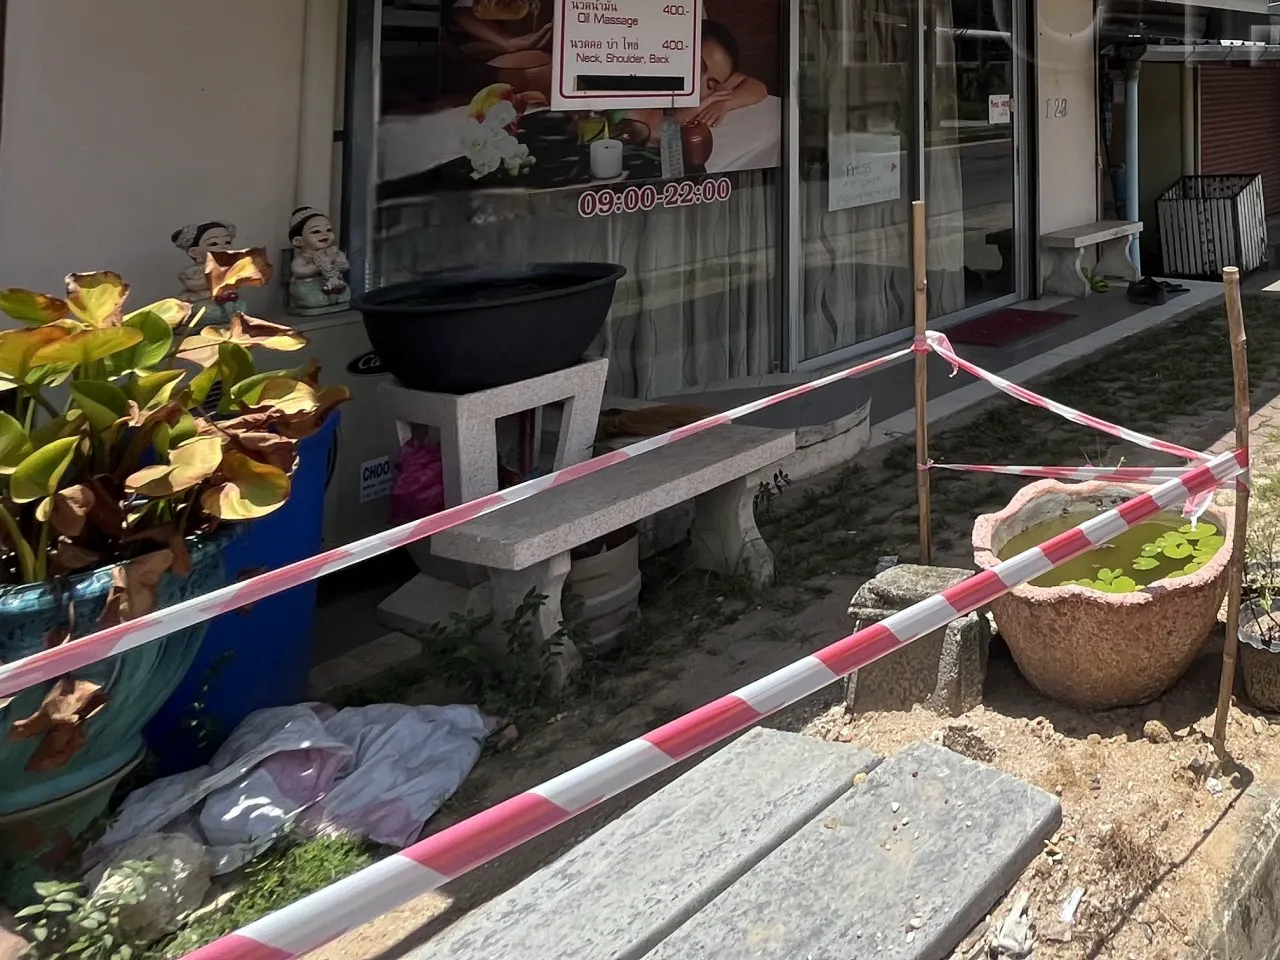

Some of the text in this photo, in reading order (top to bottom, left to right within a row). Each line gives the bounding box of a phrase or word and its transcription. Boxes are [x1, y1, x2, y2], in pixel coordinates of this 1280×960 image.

[577, 12, 639, 28] Oil Massage
[570, 39, 602, 50] นวดคอ
[576, 52, 670, 64] Neck, Shoulder, Back
[578, 178, 731, 217] 09:00-22:00
